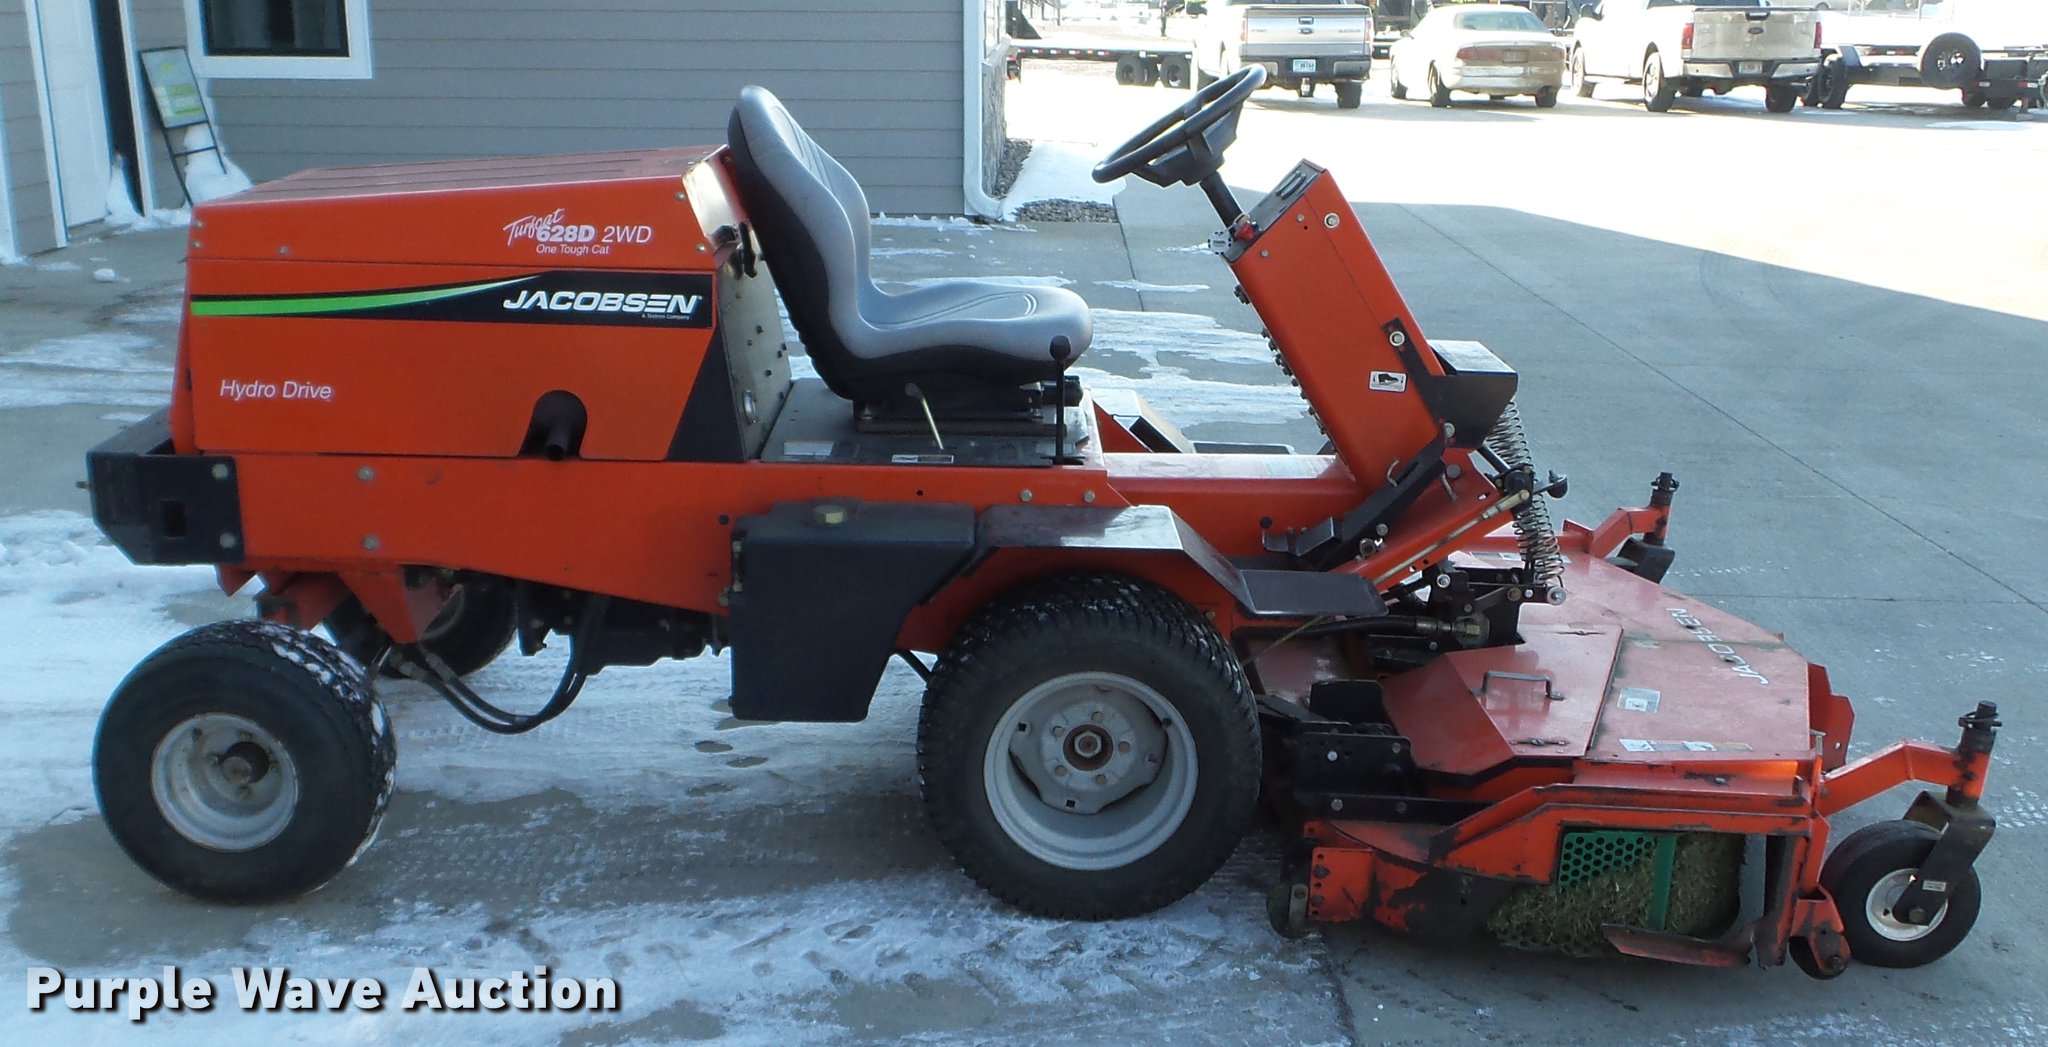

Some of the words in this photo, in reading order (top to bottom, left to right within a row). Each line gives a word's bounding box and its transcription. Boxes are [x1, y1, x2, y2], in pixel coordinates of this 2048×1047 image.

[503, 208, 565, 246] Turfcat
[536, 225, 595, 242] 628D
[602, 226, 652, 243] 2WD
[536, 244, 557, 254] One
[560, 244, 589, 256] Tough
[592, 245, 610, 255] Cat
[503, 290, 698, 314] JACOBSEN
[220, 379, 276, 401] Hydro
[282, 381, 332, 399] Drive
